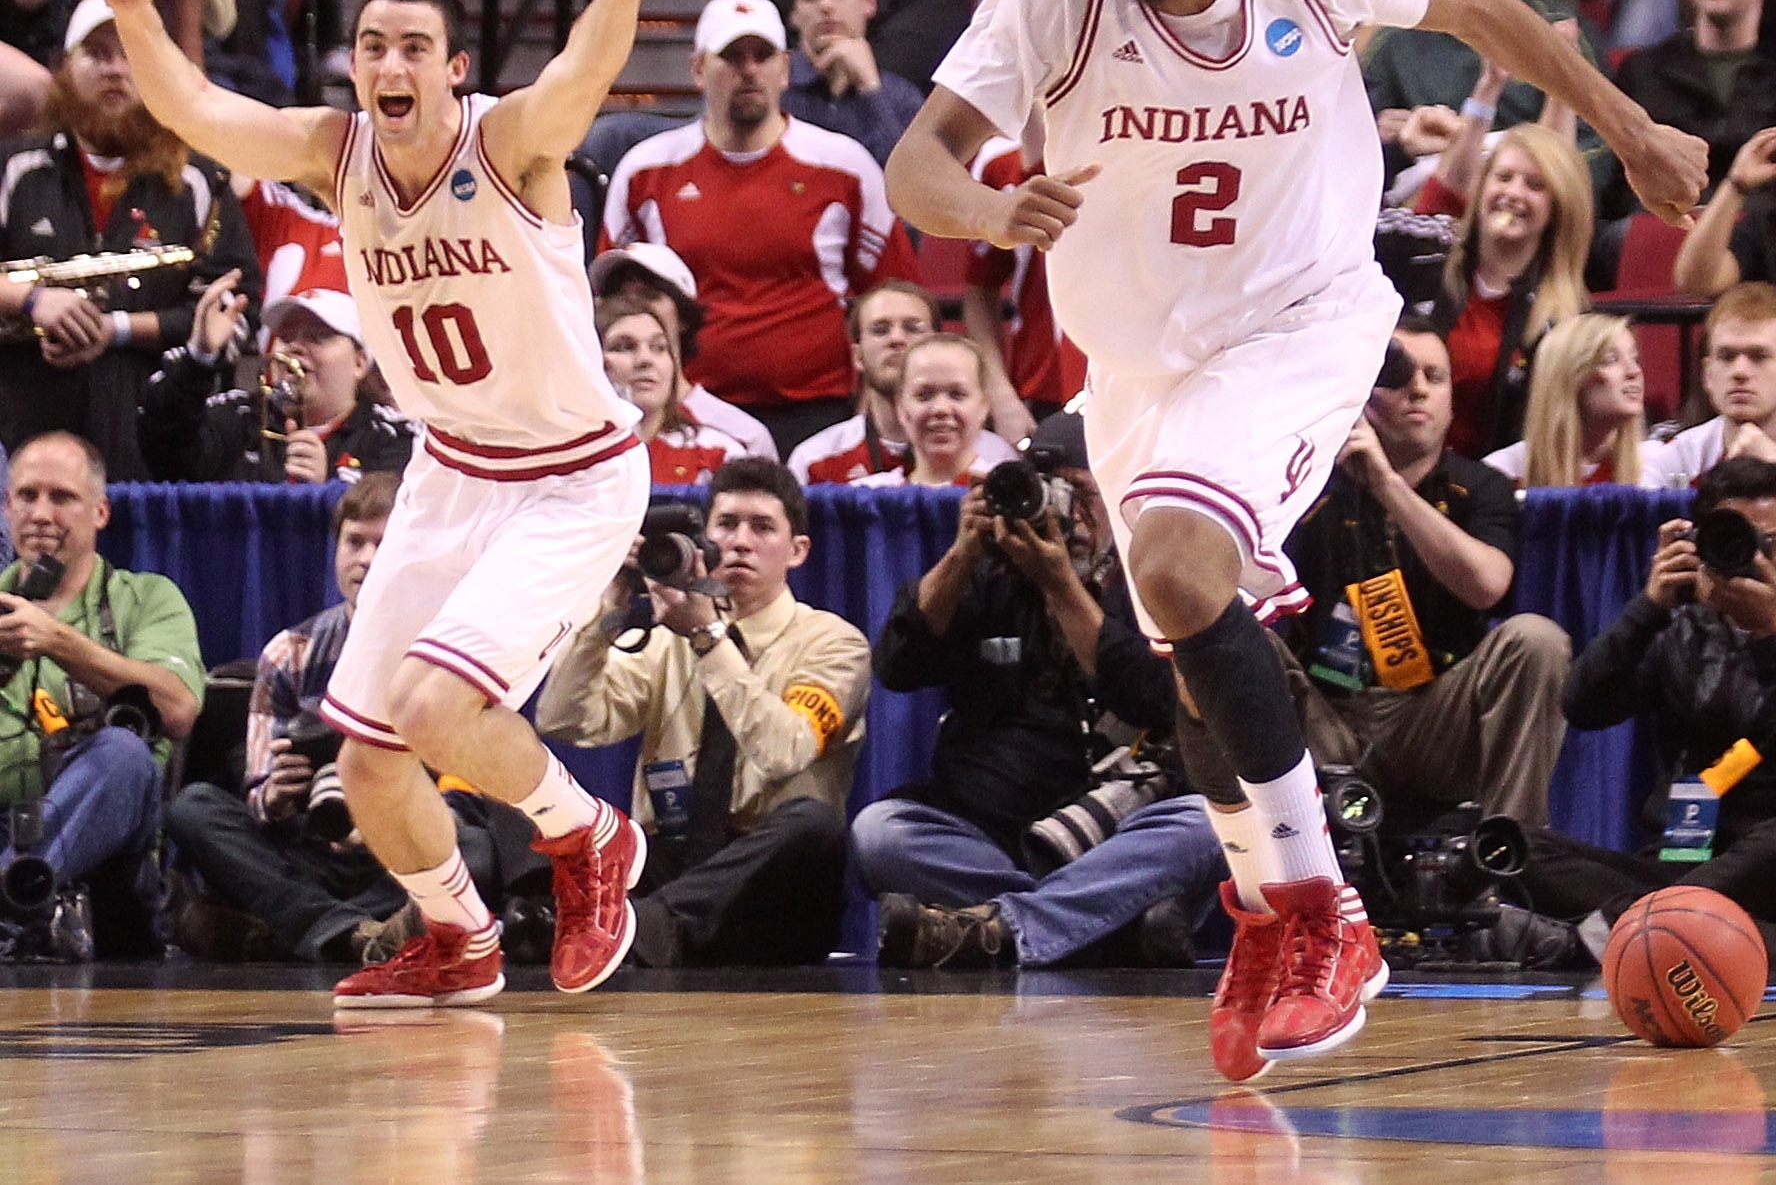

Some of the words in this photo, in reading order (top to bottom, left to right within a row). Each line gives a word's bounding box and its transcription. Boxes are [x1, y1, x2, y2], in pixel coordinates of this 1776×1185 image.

[1099, 95, 1311, 143] INDIANA
[1170, 161, 1242, 248] 2
[360, 236, 513, 286] NDIANA
[392, 301, 494, 386] 10
[1361, 578, 1419, 667] ONSHIPS
